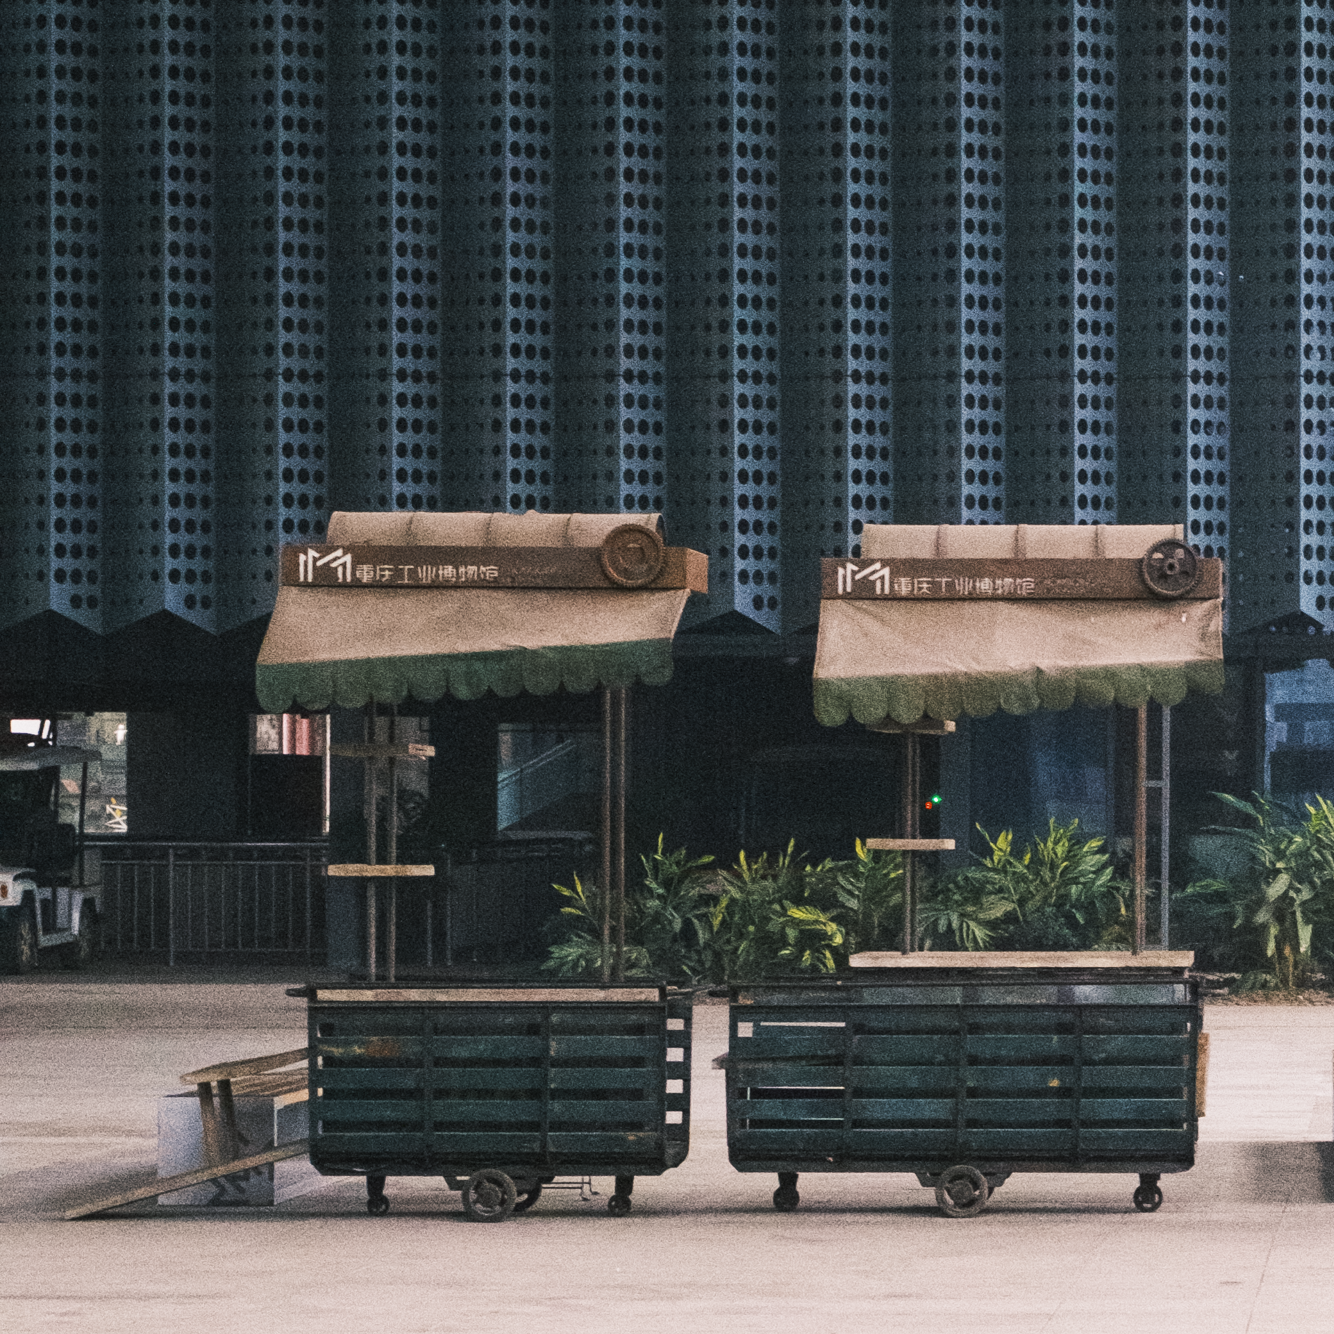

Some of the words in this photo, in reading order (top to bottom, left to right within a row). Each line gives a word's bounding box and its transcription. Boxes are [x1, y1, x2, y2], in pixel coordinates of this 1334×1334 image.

[356, 565, 499, 583] 重庆工业博物馆
[894, 577, 1035, 595] 重庆工业博物馆
